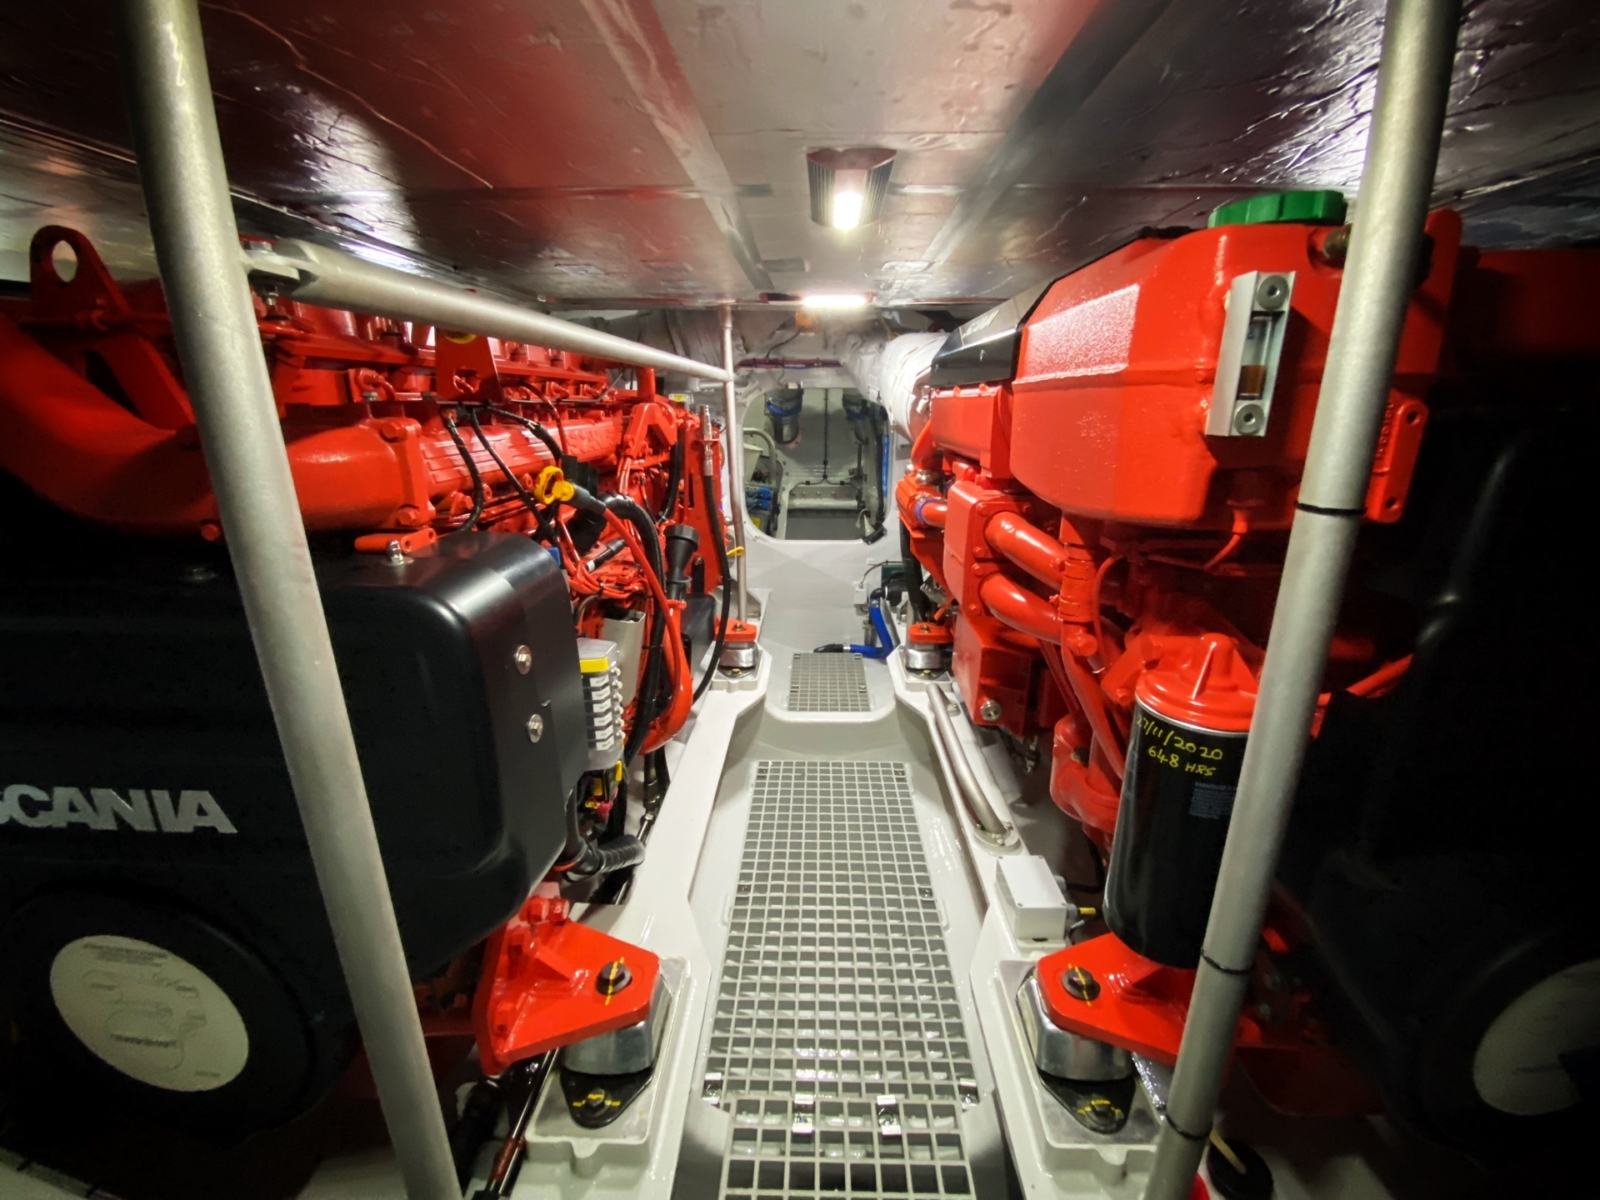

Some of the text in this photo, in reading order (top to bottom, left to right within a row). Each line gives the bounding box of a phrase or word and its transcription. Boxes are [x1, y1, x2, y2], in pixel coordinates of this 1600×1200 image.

[1148, 746, 1217, 776] 648 HRS
[0, 784, 238, 833] CANIA
